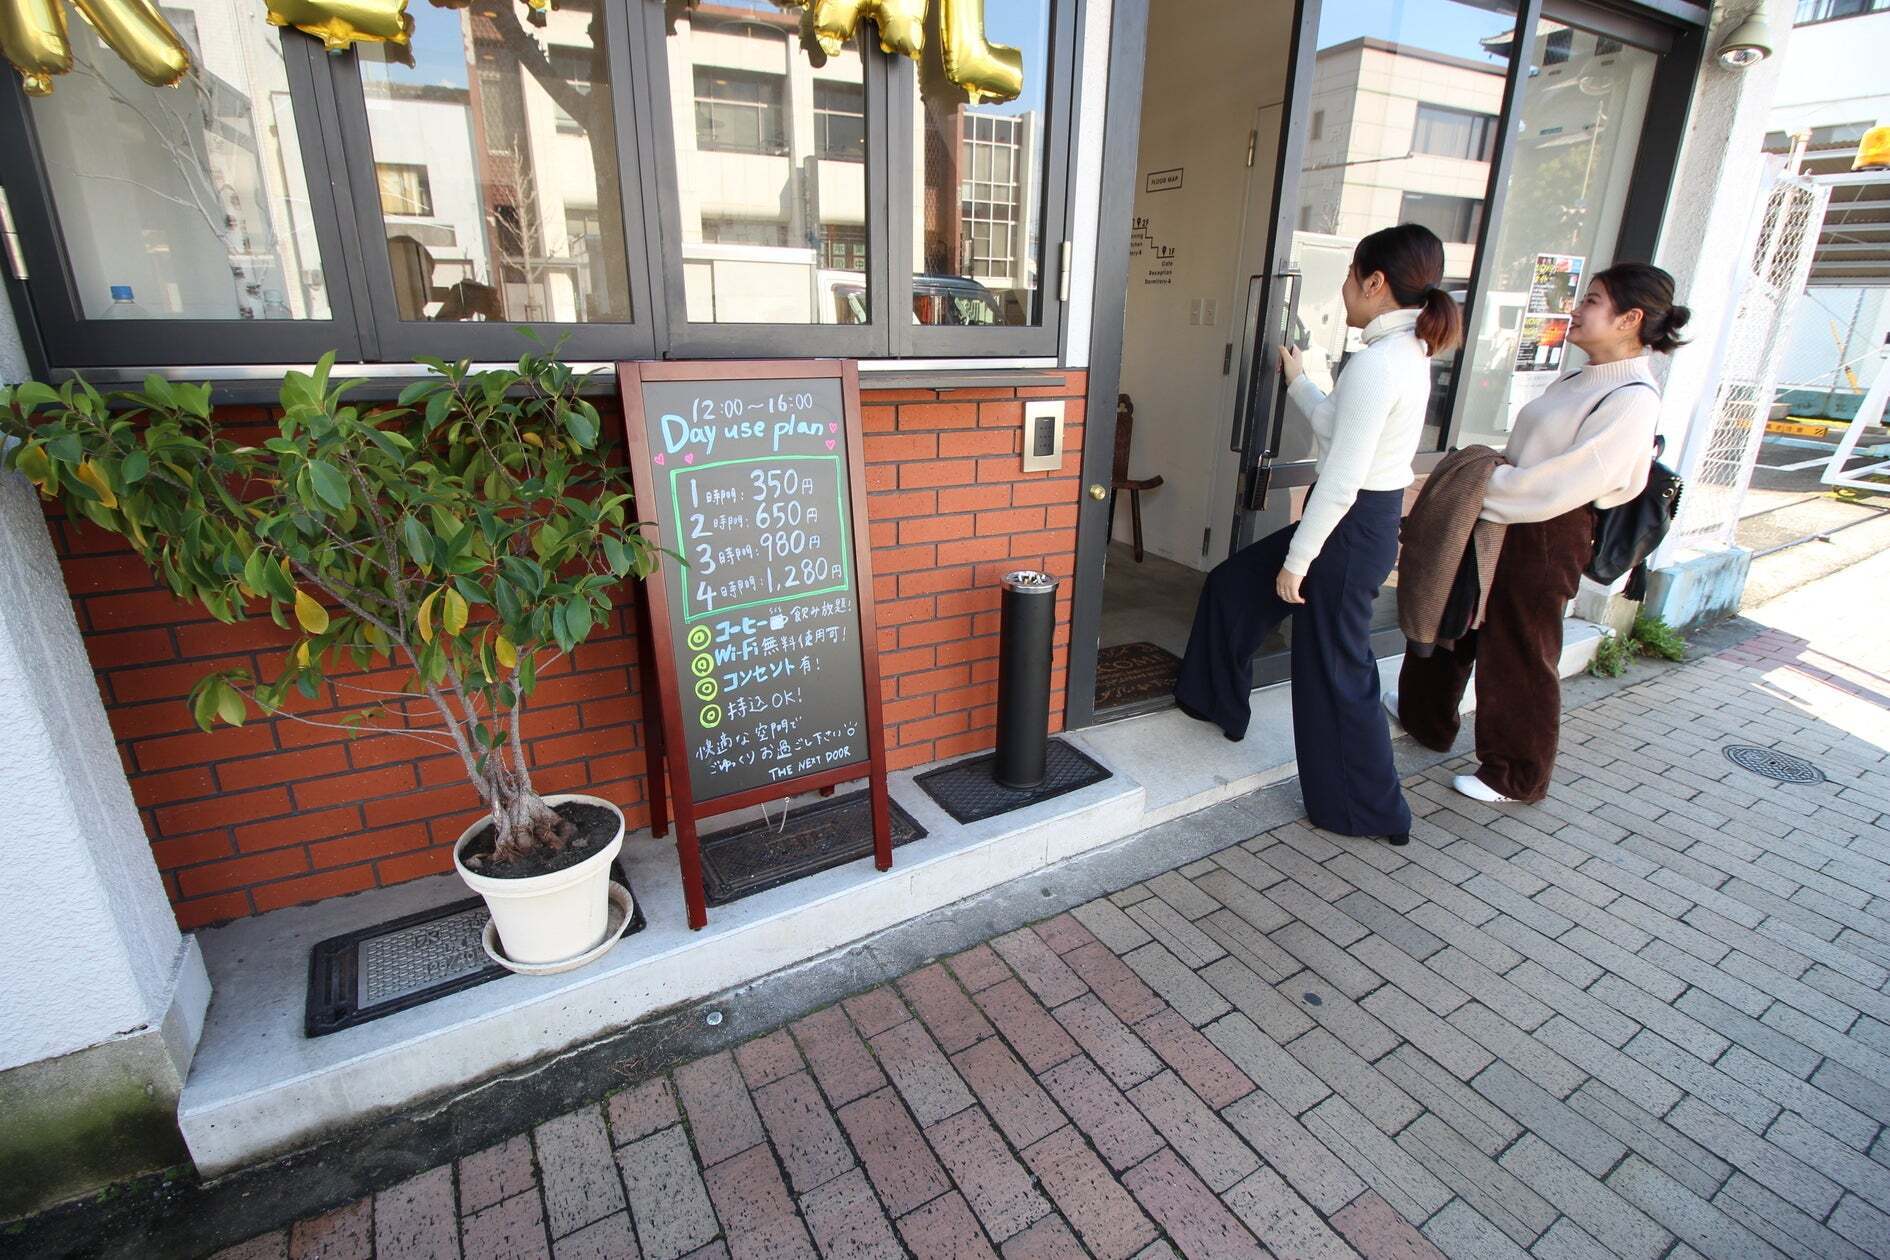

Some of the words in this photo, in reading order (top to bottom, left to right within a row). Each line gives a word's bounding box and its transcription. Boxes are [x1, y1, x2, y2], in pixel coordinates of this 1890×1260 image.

[660, 414, 717, 455] Day
[724, 420, 764, 438] use
[773, 414, 824, 452] plan
[715, 617, 769, 643] コーヒー
[722, 658, 795, 693] コンセント
[768, 765, 793, 781] THE
[798, 755, 821, 776] NEXT
[825, 745, 851, 764] DOOR
